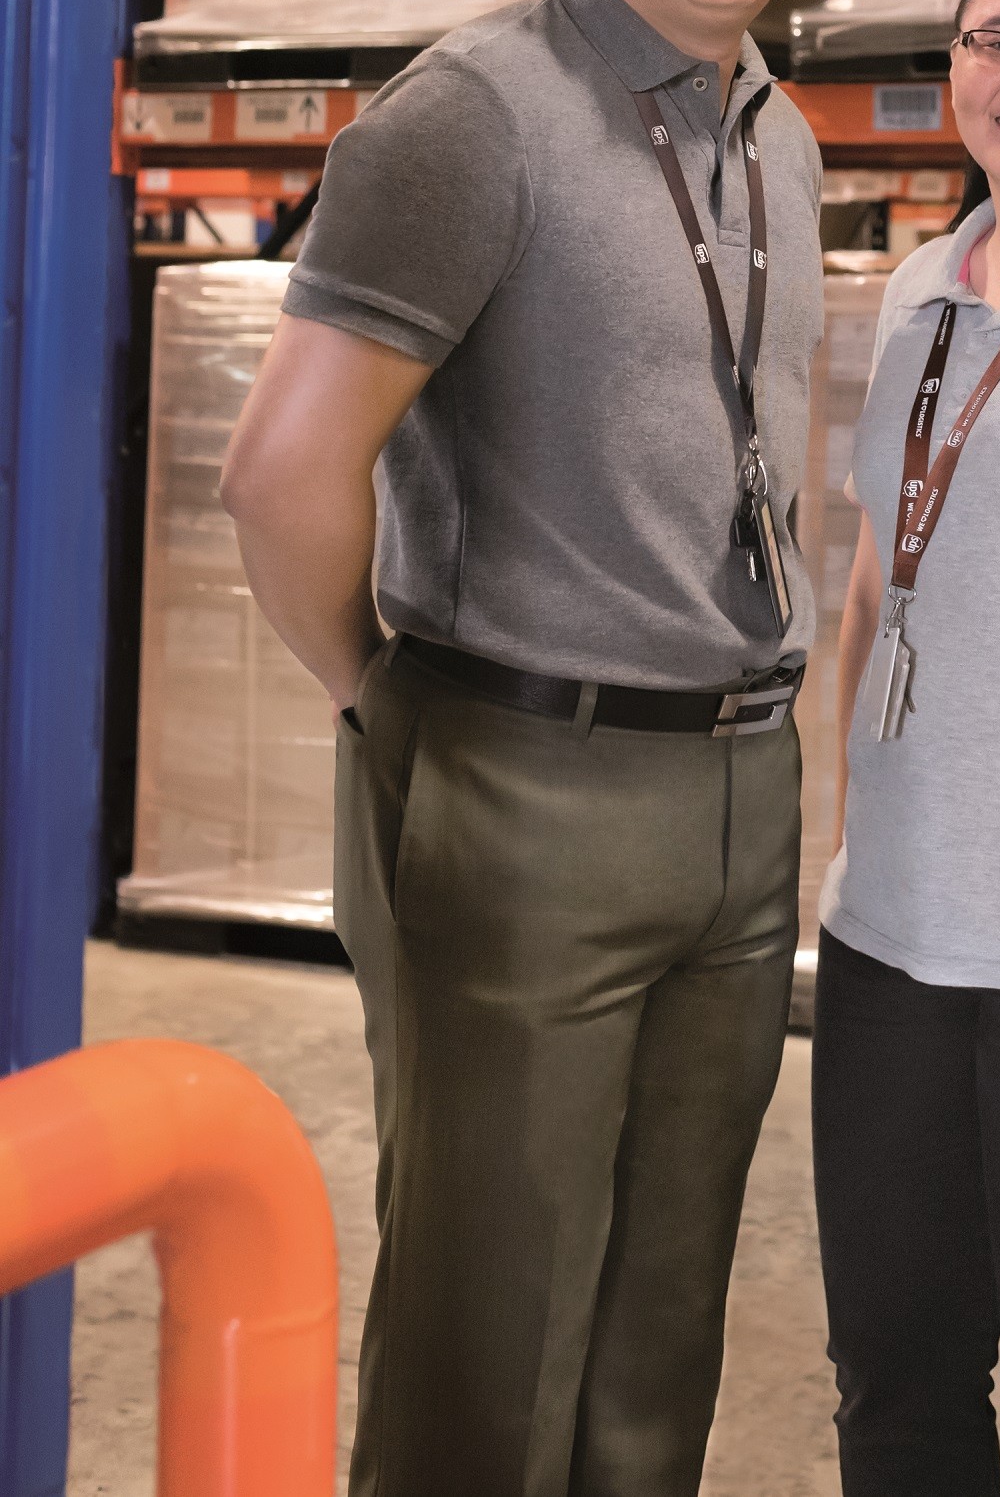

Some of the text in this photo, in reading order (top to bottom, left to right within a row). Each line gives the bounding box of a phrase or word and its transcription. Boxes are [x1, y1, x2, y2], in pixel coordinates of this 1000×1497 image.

[653, 127, 665, 144] ups
[697, 244, 706, 262] ups
[915, 411, 926, 438] LOGISTICS
[951, 431, 961, 446] ups
[907, 481, 918, 497] ups
[907, 502, 914, 512] WE
[917, 488, 939, 532] WE LOGISTICS
[907, 536, 920, 552] ups
